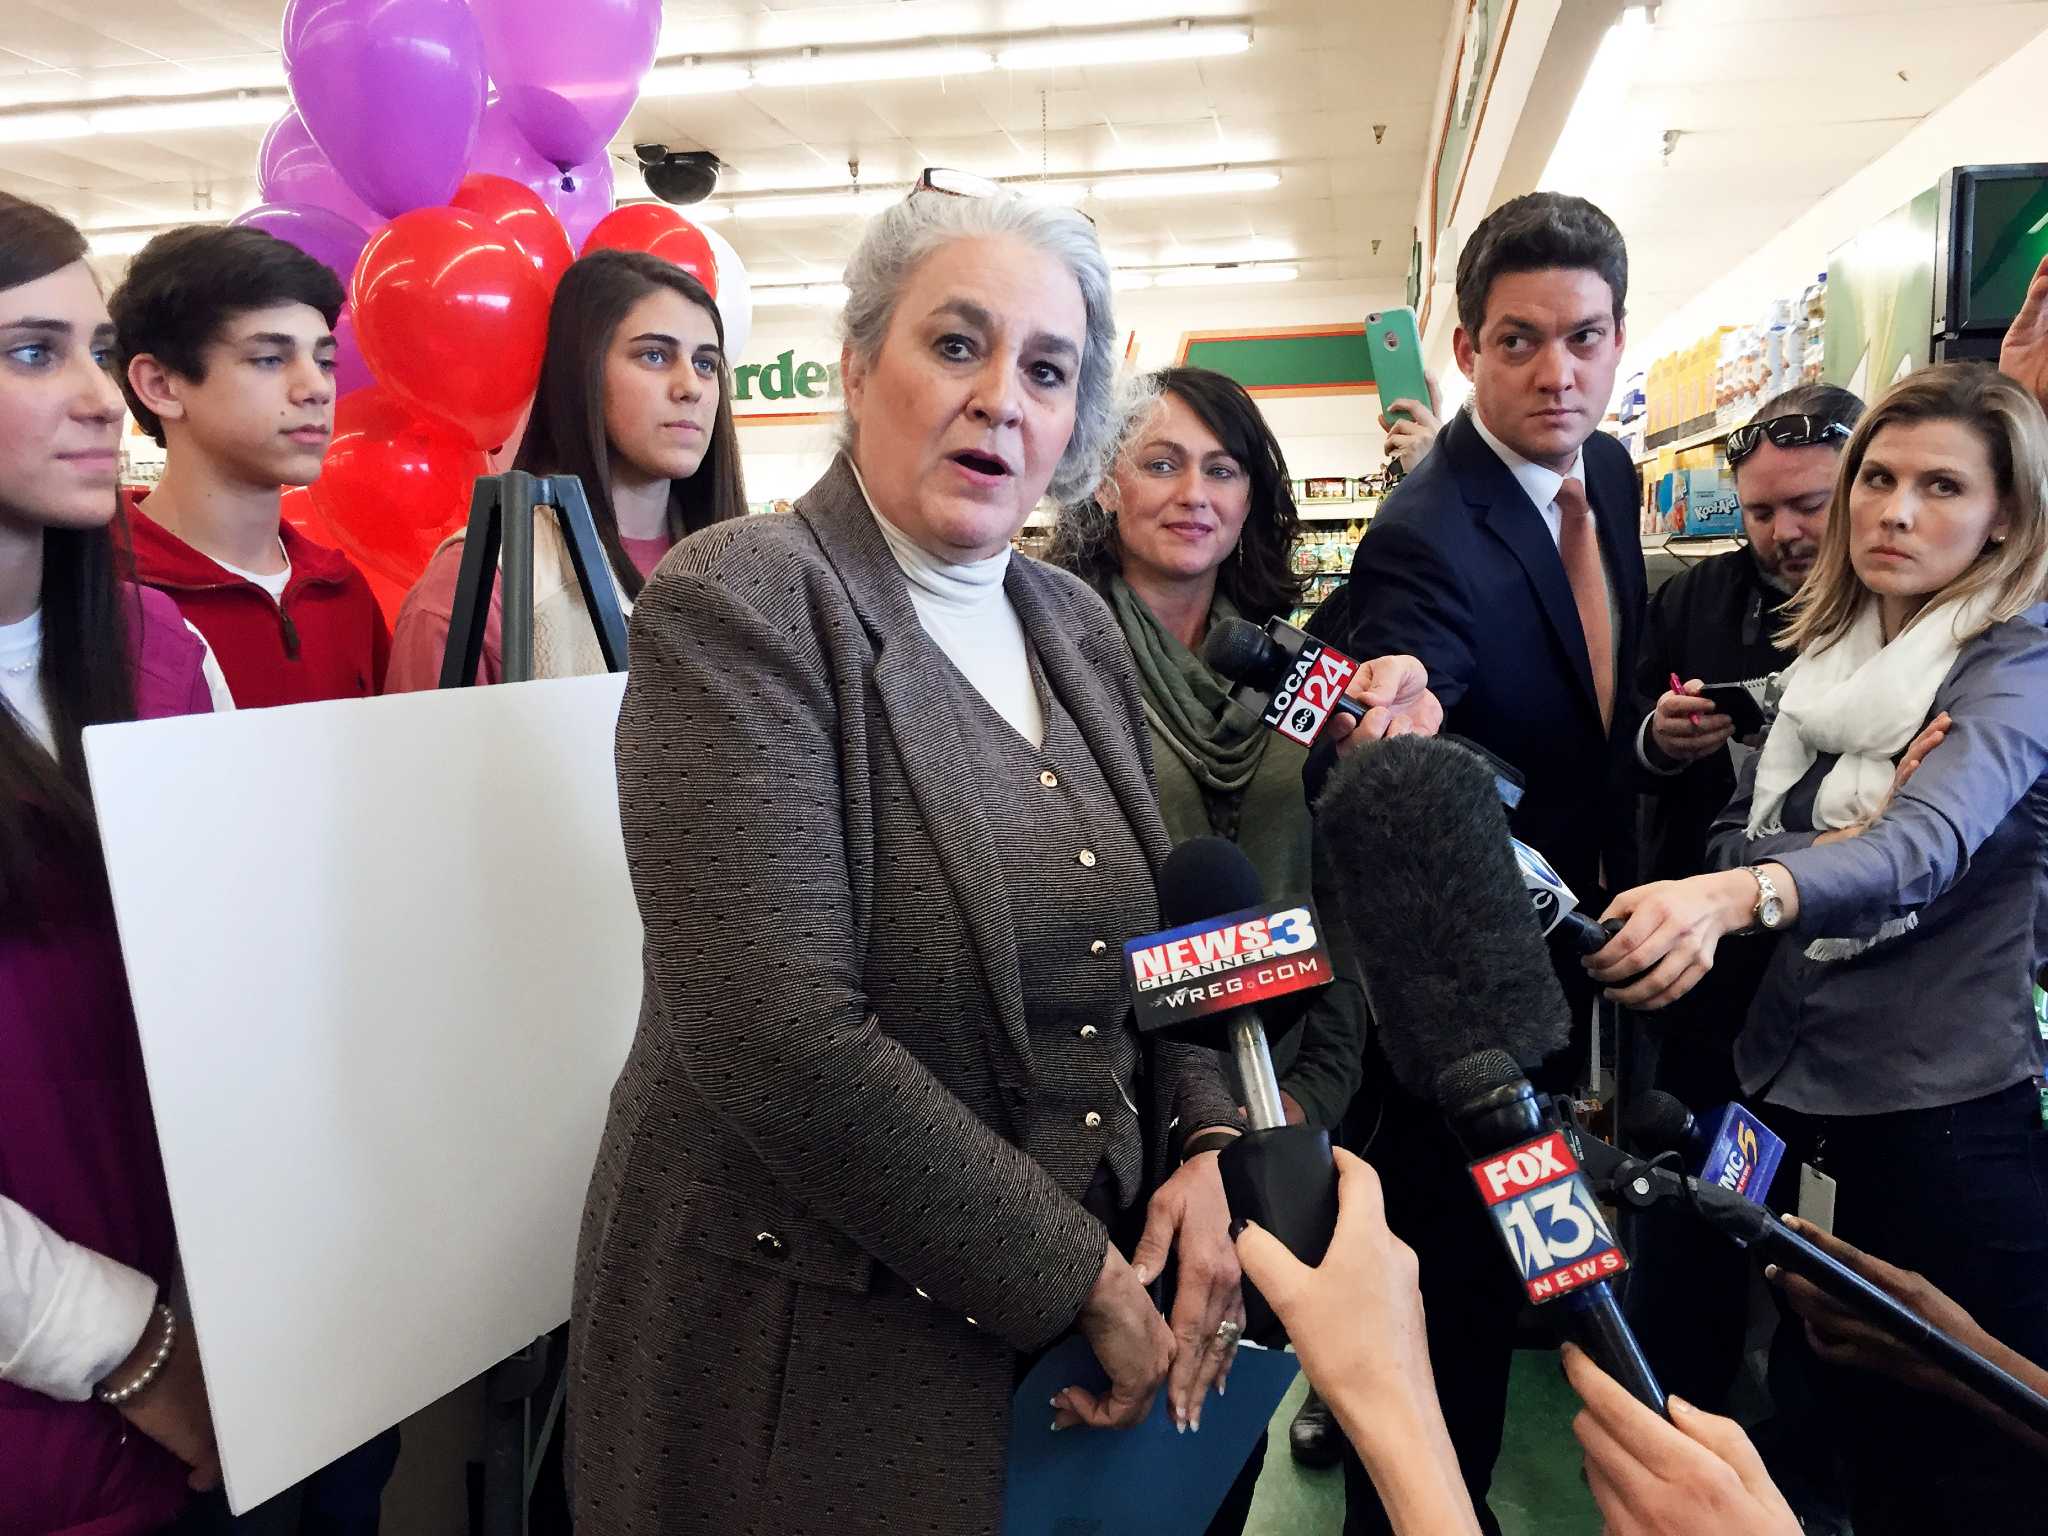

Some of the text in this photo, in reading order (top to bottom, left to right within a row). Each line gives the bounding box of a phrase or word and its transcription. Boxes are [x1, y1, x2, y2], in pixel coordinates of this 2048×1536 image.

[1264, 647, 1321, 726] LOCAL
[1295, 654, 1353, 732] abc 24
[1132, 907, 1318, 979] NEWS 3
[1138, 948, 1275, 991] CHANNEL
[1166, 957, 1318, 1009] WREG.COM
[1483, 1139, 1568, 1197] FOX
[1718, 1150, 1745, 1191] MC
[1737, 1120, 1757, 1168] 5
[1504, 1180, 1595, 1271] 13
[1534, 1253, 1619, 1296] NEWS
